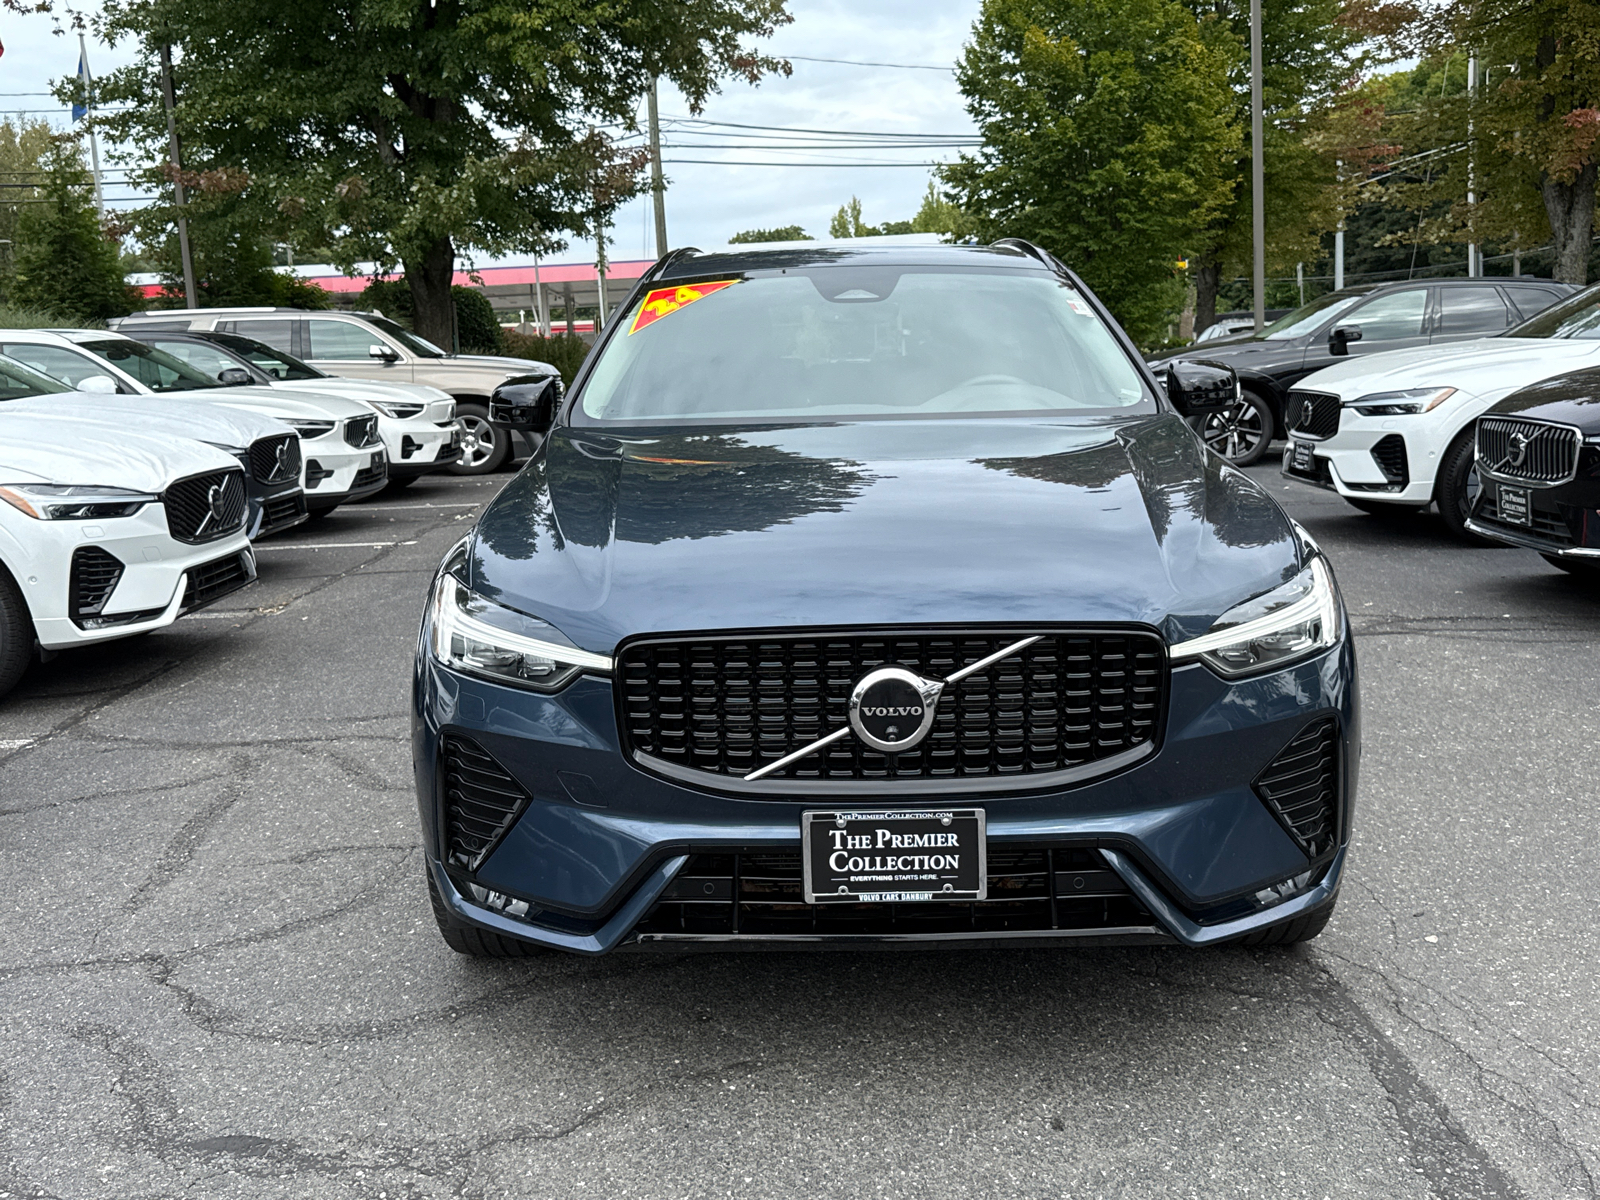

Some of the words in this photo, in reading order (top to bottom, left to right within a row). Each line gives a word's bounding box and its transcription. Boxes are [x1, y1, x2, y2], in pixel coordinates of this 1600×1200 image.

[644, 287, 703, 316] 24
[861, 706, 923, 717] VOLVO
[829, 829, 872, 849] THE
[875, 829, 960, 848] PREMIER
[829, 851, 960, 872] COLLECTION
[850, 874, 893, 882] EVERYTHING
[858, 893, 880, 901] VOLVO
[882, 893, 899, 901] CARS
[901, 892, 933, 900] DANBURY
